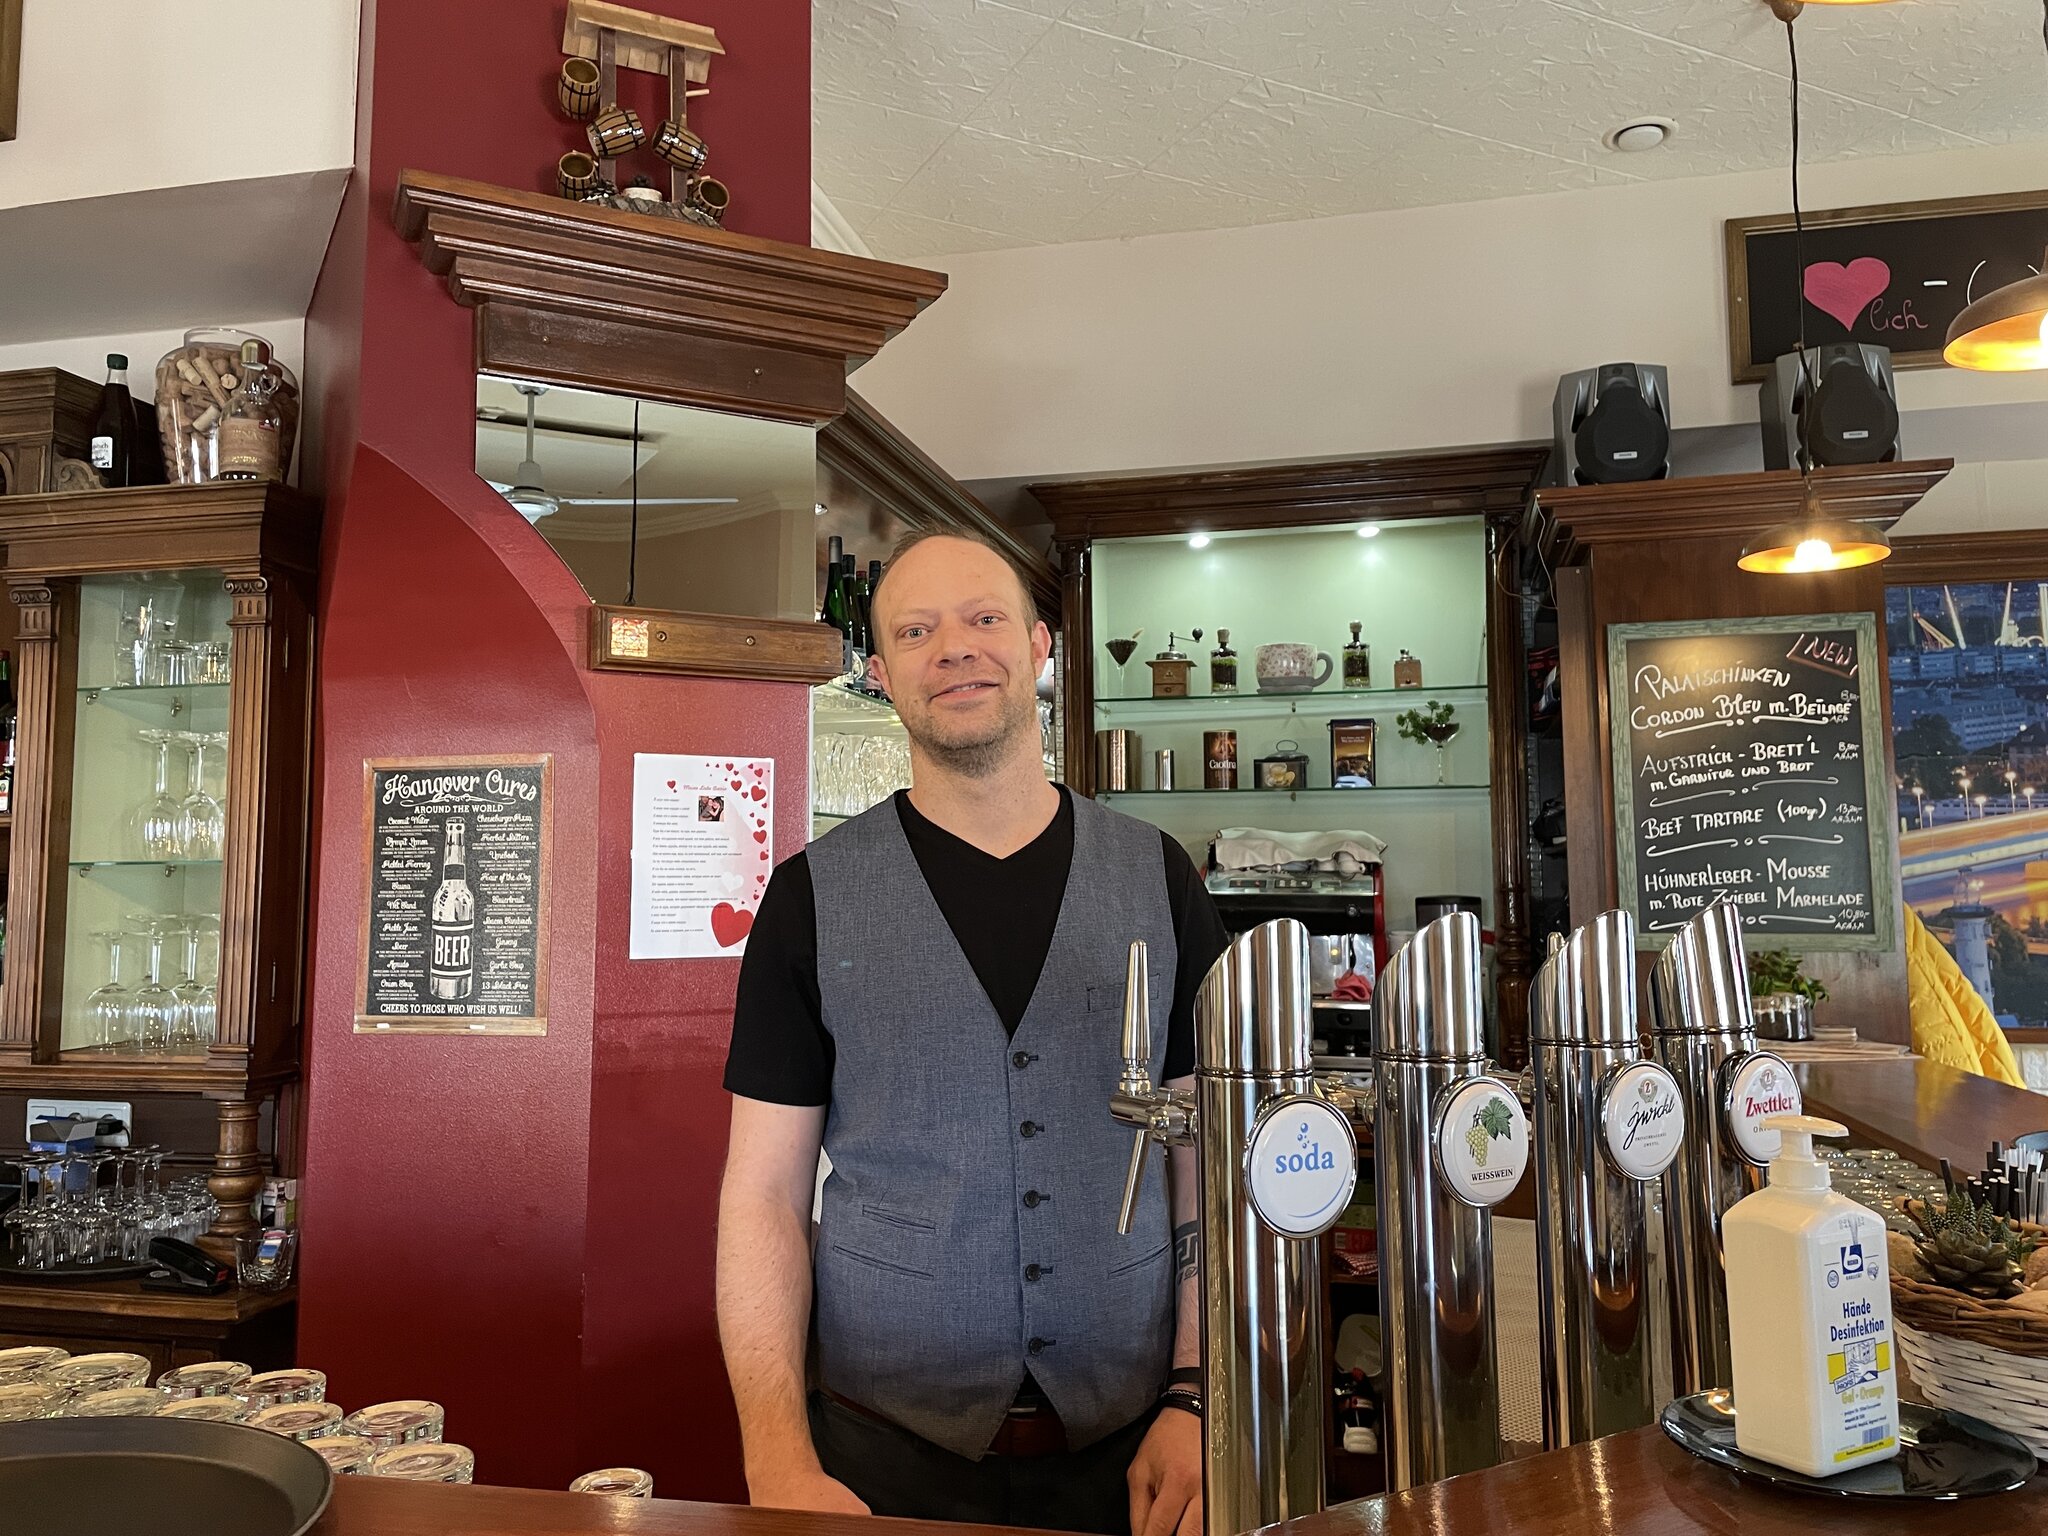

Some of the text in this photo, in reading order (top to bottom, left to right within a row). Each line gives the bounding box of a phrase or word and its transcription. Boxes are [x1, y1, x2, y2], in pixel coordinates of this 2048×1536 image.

[1870, 298, 1928, 331] lich
[1631, 705, 1705, 730] CORDON
[1640, 745, 1733, 777] AUFSTRICH
[1669, 768, 1734, 787] GARNITUR
[1741, 765, 1770, 777] UND
[1777, 760, 1814, 774] BROT
[383, 769, 537, 804] Hangover Cures
[414, 804, 503, 814] AROUND THE WORLD
[1641, 816, 1684, 840] BEEF
[1691, 808, 1765, 831] TARTARE
[1766, 857, 1831, 883] MOUSSE
[1777, 886, 1864, 909] MARMELADE
[434, 934, 470, 967] BEER
[482, 981, 490, 989] 13
[380, 1003, 521, 1014] CHEERS TO THOSE WHO WISH US WELL!
[1745, 1093, 1794, 1117] Zwettler
[1275, 1143, 1335, 1174] soda
[1471, 1168, 1513, 1181] WEISSWEIN
[1842, 1297, 1871, 1319] Hände
[1830, 1318, 1885, 1342] Desinfektion
